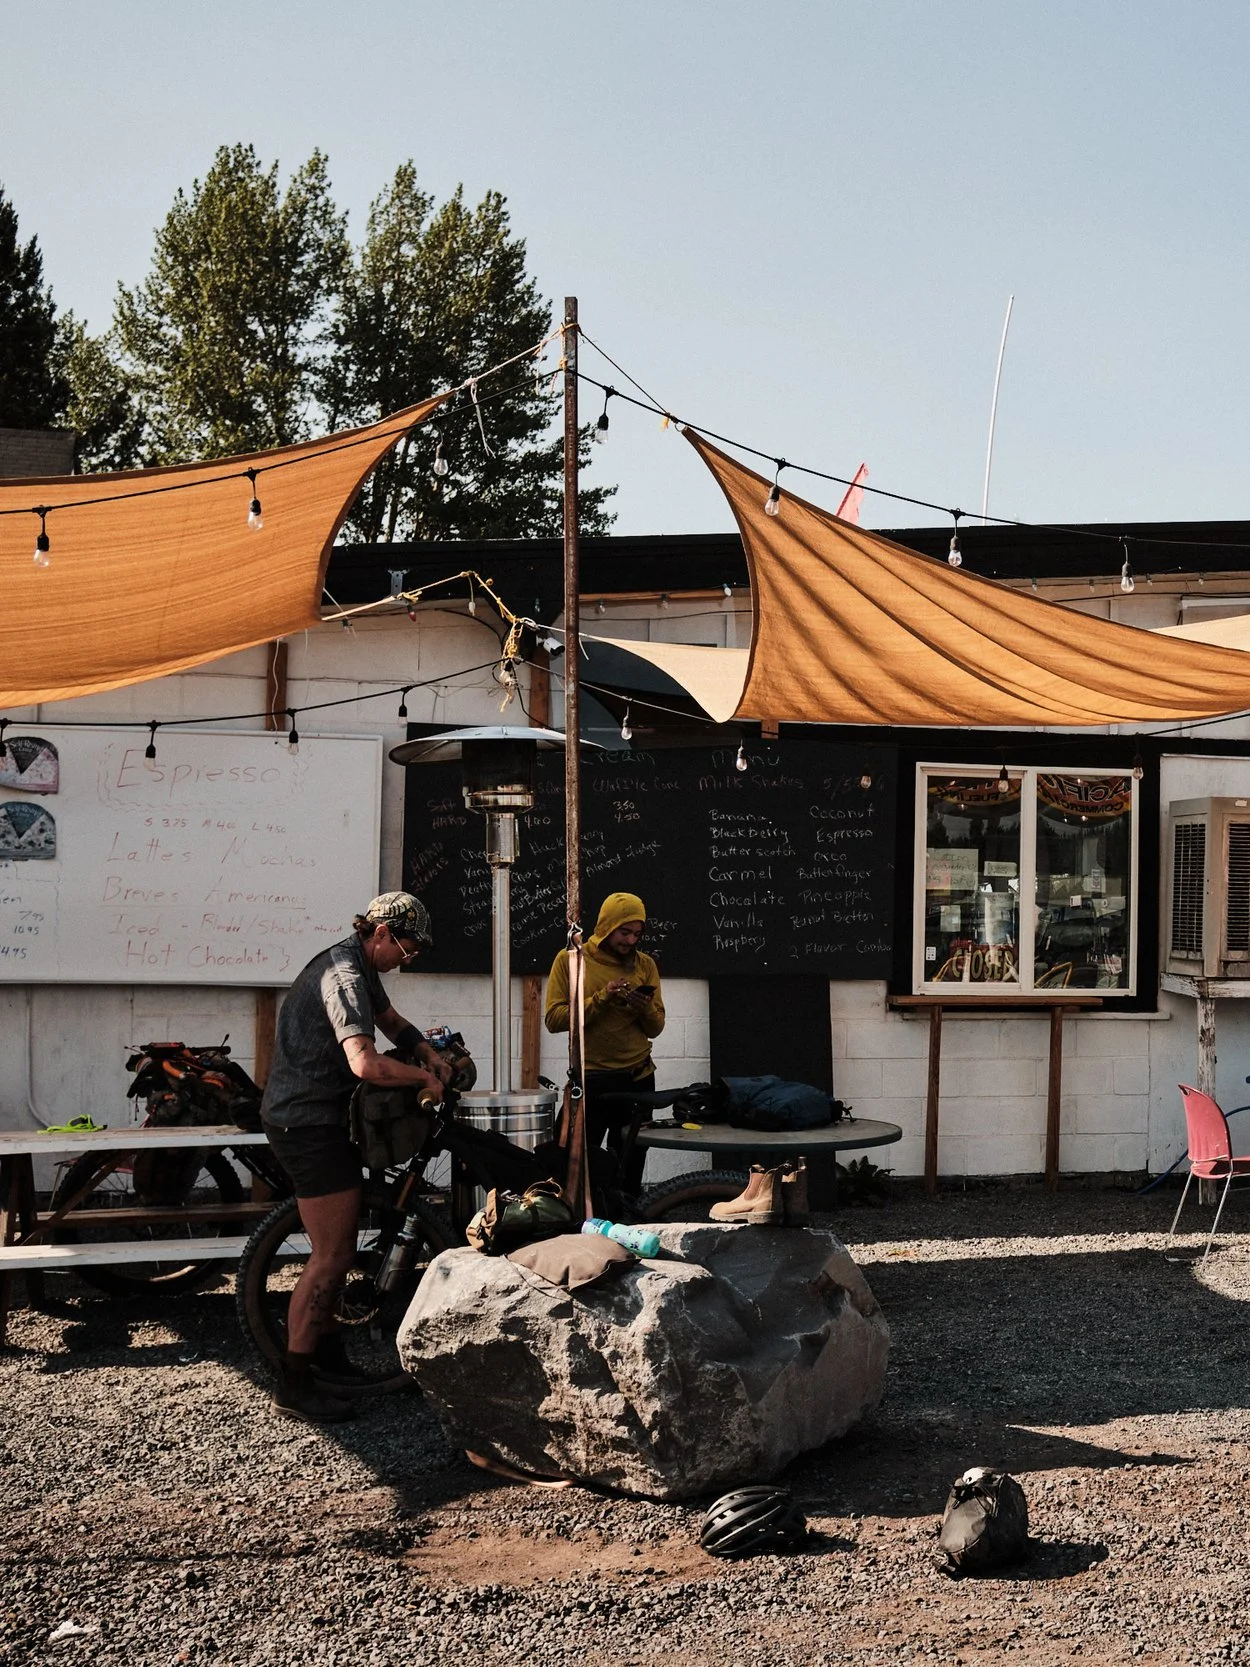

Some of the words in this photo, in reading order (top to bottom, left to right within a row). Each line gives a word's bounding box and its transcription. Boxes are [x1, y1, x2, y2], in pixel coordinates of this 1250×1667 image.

[117, 749, 281, 798] Espresso
[699, 774, 743, 791] Milk
[106, 831, 192, 863] Lattes
[126, 940, 176, 967] Hot
[187, 944, 270, 968] Chocolate
